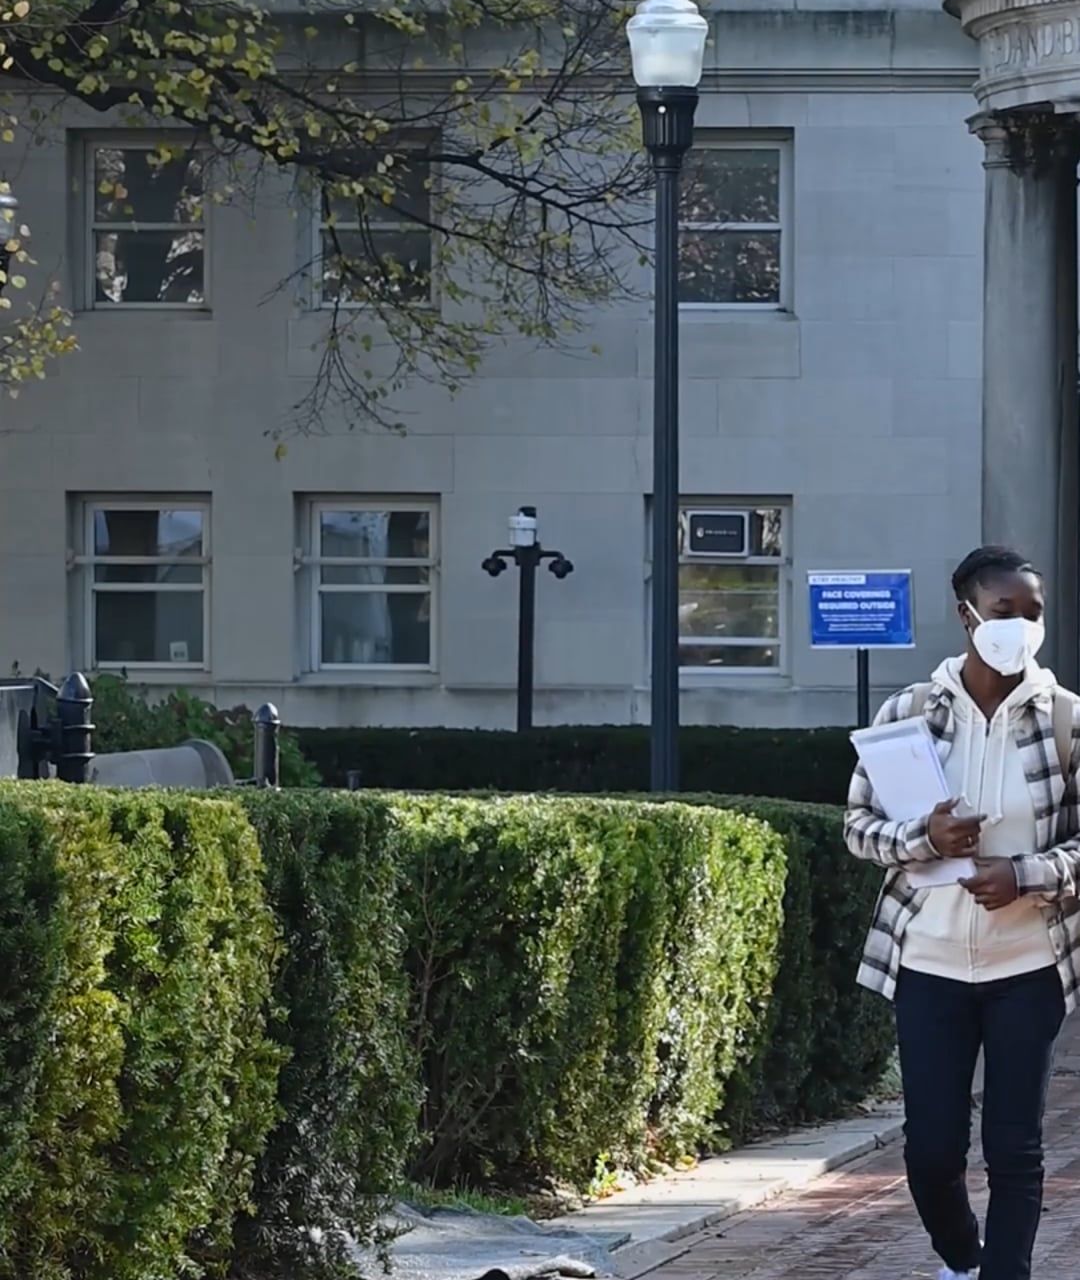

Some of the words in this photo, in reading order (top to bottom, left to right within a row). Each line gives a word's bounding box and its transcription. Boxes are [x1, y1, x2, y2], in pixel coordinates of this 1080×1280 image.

[822, 590, 842, 598] FACE
[844, 590, 891, 598] COVERINGS
[818, 601, 859, 610] REQUIRED
[860, 601, 896, 609] OUTSIDE
